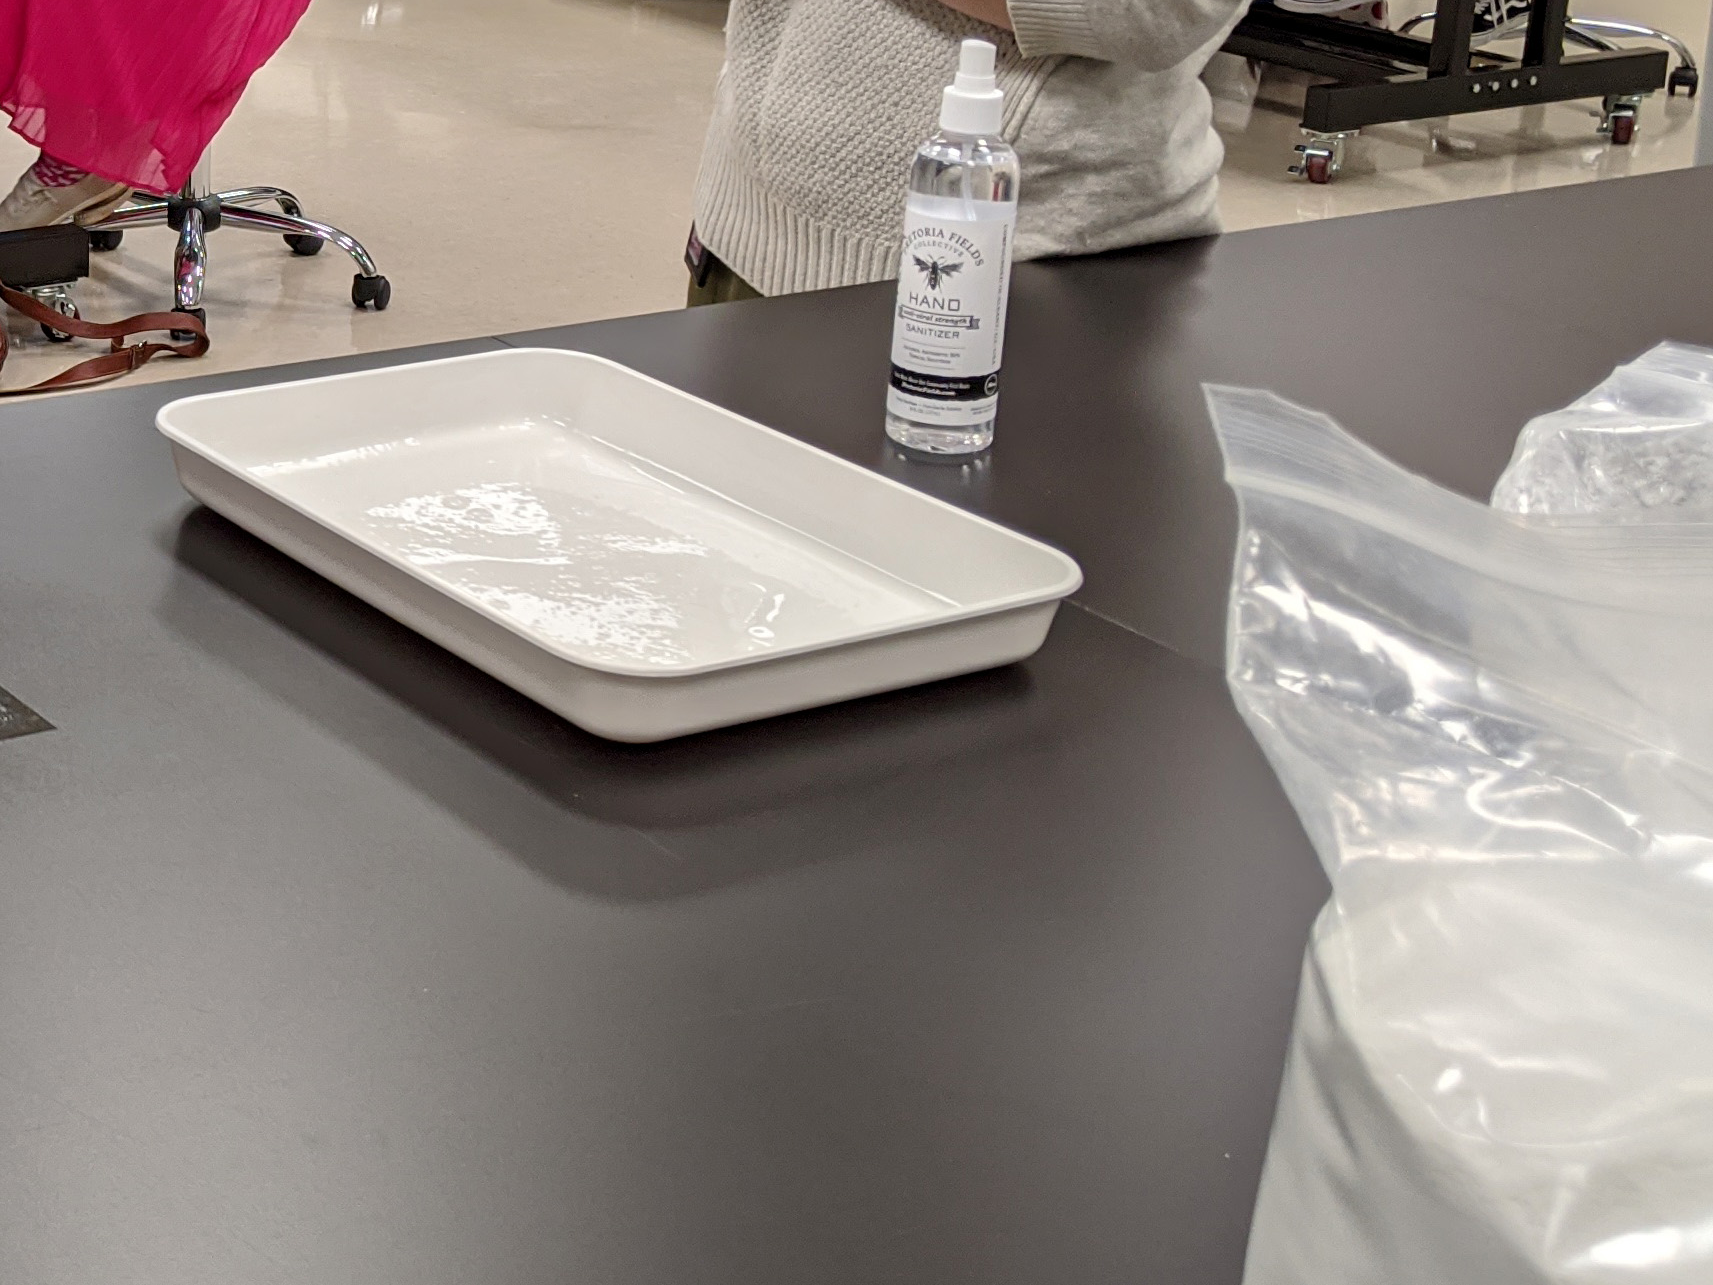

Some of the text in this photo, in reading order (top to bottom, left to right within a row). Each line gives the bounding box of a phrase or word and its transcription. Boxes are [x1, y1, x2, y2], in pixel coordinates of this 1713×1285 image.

[913, 240, 964, 257] COLLECTIVE
[948, 232, 984, 267] FIELDS
[909, 292, 961, 311] HAND
[905, 324, 960, 339] SANITIZER
